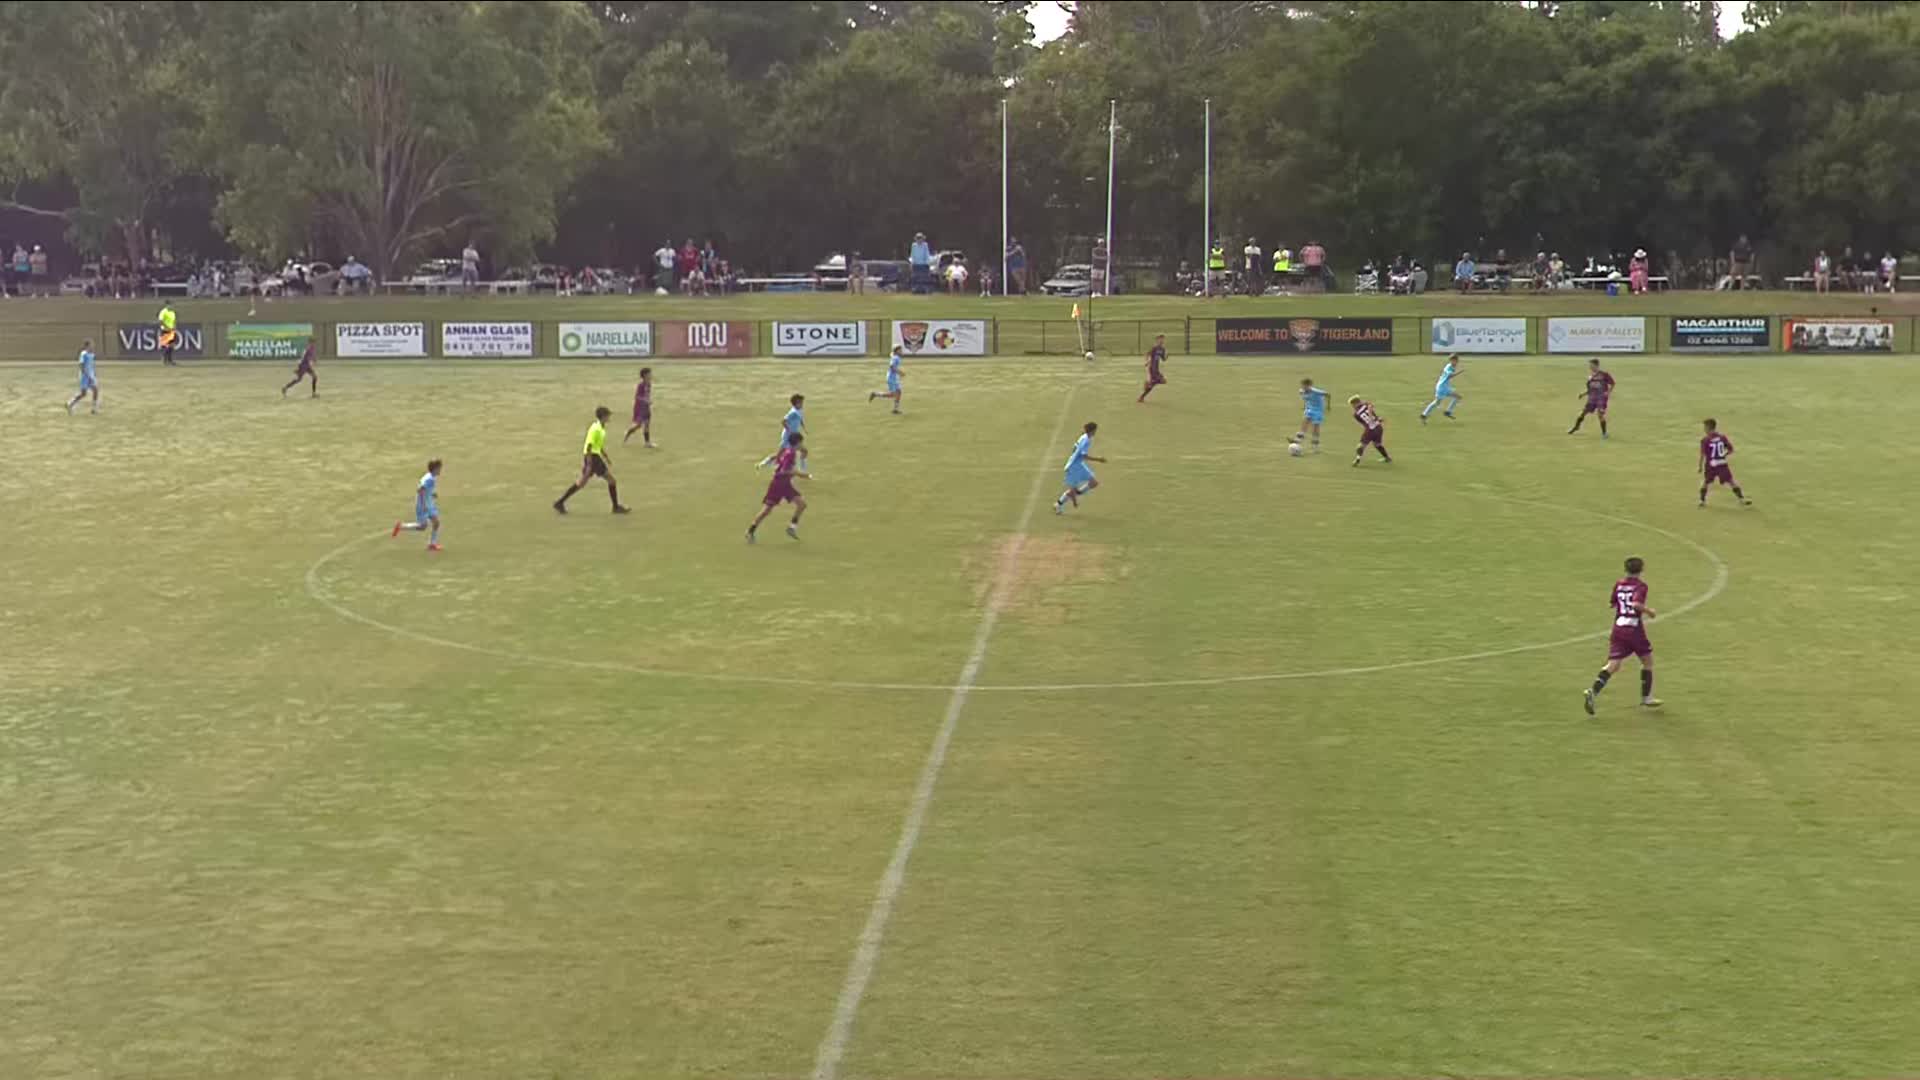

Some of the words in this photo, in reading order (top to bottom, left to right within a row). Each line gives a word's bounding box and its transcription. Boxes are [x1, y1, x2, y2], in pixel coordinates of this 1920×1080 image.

[1676, 318, 1766, 328] MACARTHUR
[339, 325, 380, 337] PIZZA
[383, 325, 421, 337] SPOT
[445, 325, 487, 336] ANNAN
[490, 325, 529, 336] GLASS
[785, 327, 852, 340] STONE
[1218, 328, 1270, 342] WELCOME
[1274, 328, 1289, 341] TO
[1322, 328, 1390, 341] TIGERLAND
[586, 332, 648, 345] NARELLAN
